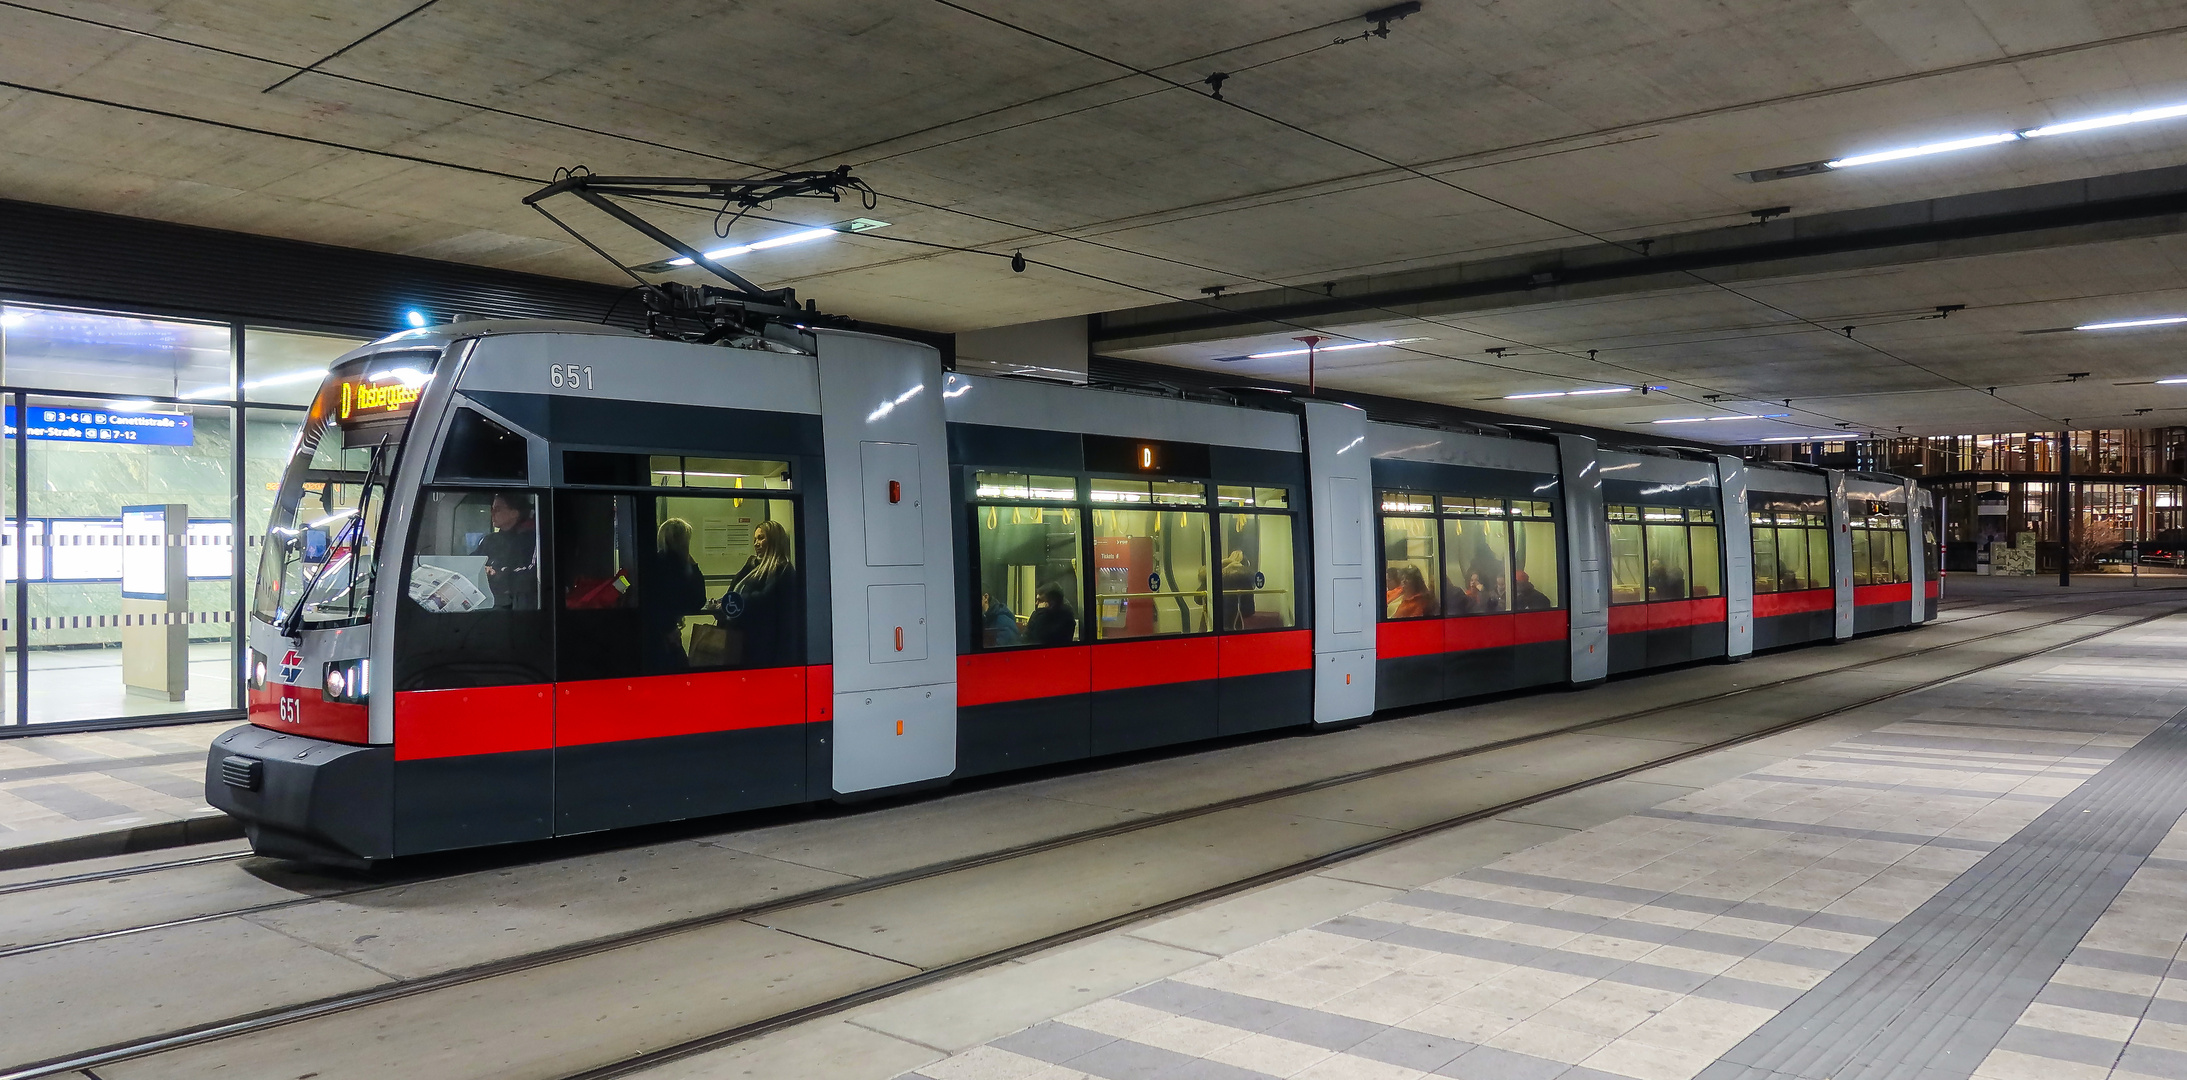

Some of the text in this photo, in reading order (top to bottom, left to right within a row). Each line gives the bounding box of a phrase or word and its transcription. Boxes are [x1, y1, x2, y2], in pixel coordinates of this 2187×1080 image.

[550, 363, 594, 390] 651
[341, 382, 351, 419] D
[109, 416, 175, 428] Canettistraße
[113, 431, 137, 440] 7-12
[1144, 448, 1151, 467] D
[280, 697, 299, 723] 651
